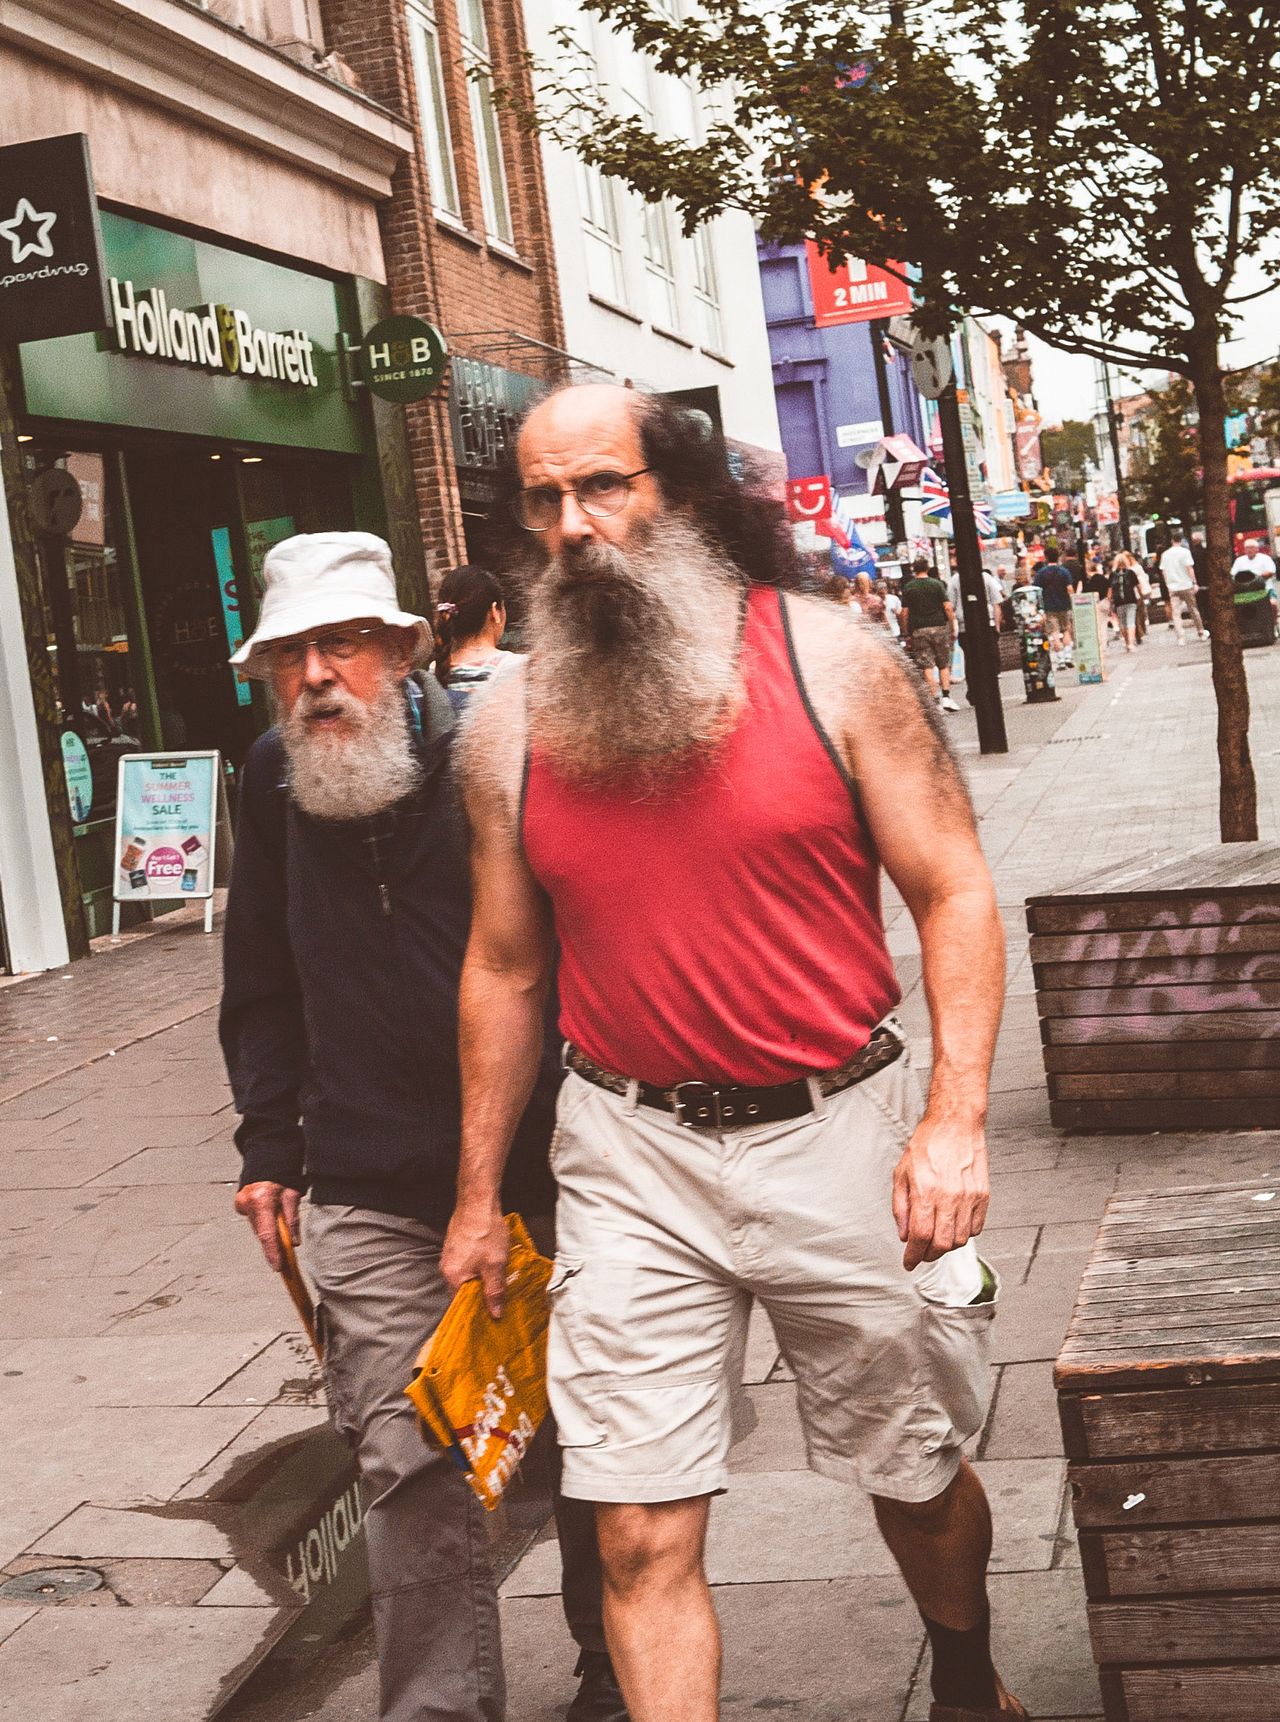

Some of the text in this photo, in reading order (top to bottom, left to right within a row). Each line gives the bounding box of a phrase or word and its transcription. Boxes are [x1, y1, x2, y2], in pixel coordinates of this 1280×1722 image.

[833, 281, 888, 307] 2 MIN
[108, 277, 224, 368] Holland
[233, 309, 319, 387] Barrett
[373, 367, 434, 383] SINCE 1870
[160, 772, 177, 780] THE
[144, 781, 191, 792] SUMMER
[141, 792, 195, 804] WELLNESS
[152, 804, 181, 816] SALE
[147, 860, 183, 876] Free
